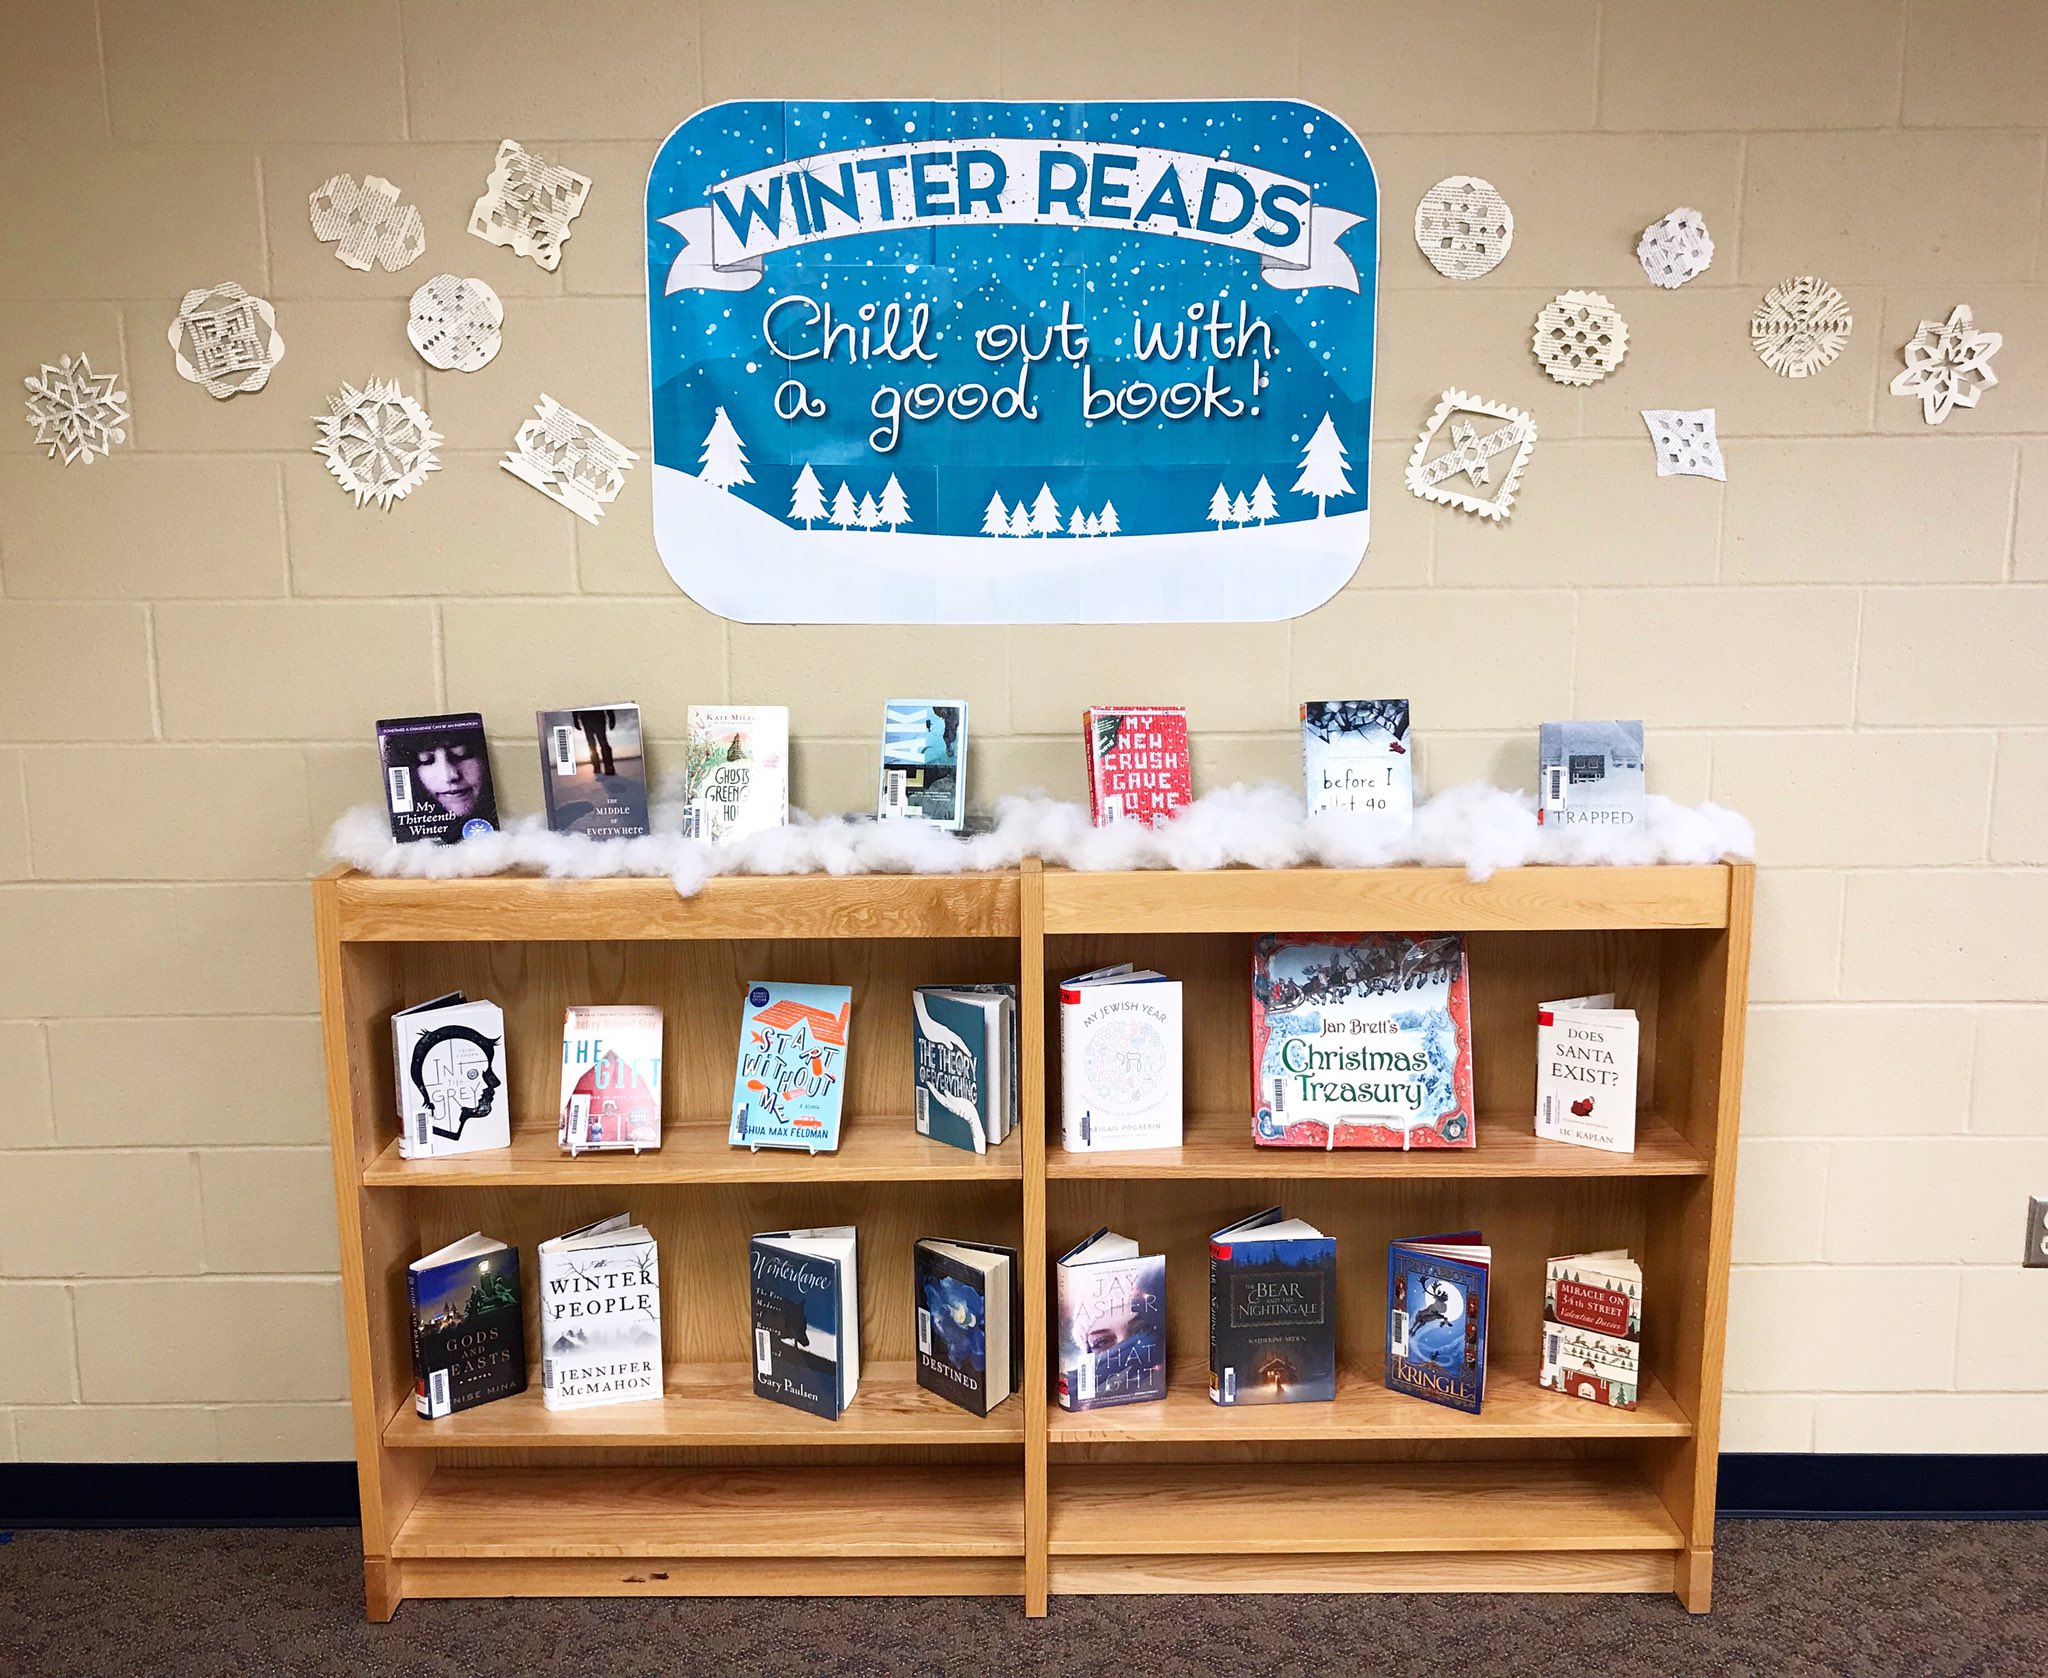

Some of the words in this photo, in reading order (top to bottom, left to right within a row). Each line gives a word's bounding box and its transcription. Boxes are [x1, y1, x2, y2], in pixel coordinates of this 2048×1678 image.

[713, 150, 1006, 248] WINTER
[1038, 150, 1310, 248] READS
[762, 294, 938, 361] Chill
[976, 301, 1088, 362] out
[1133, 301, 1279, 362] with
[774, 382, 826, 418] a
[868, 362, 1037, 453] good
[1082, 364, 1263, 419] book!
[1126, 717, 1152, 730] MY
[1119, 733, 1162, 750] NEW
[1104, 752, 1177, 770] CRUSH
[715, 767, 749, 785] GHOSTS
[1113, 772, 1171, 790] GAVE
[1323, 768, 1376, 790] before
[1387, 767, 1393, 786] I
[416, 802, 435, 813] My
[1151, 792, 1180, 809] ME
[397, 811, 456, 826] Thirteenth
[1553, 810, 1634, 824] TRAPPED
[409, 824, 448, 836] Winter
[1084, 1012, 1098, 1028] MY
[1100, 1002, 1139, 1018] JEWISH
[1142, 1002, 1167, 1023] YEAR
[1320, 1018, 1346, 1038] Jan
[1350, 1018, 1398, 1035] Brett's
[1568, 1028, 1604, 1043] DOES
[563, 1040, 603, 1064] THE
[758, 1027, 840, 1067] START
[1282, 1038, 1428, 1074] Christmas
[1556, 1044, 1614, 1064] SANTA
[918, 1038, 936, 1068] THE
[938, 1044, 978, 1082] THEORY
[594, 1058, 660, 1089] GIFT
[1552, 1062, 1619, 1086] EXIST?
[919, 1068, 930, 1084] OF
[930, 1068, 978, 1105] EVERYTHING
[1294, 1072, 1422, 1110] Treasury
[758, 1086, 790, 1124] ME
[744, 1124, 766, 1136] SHUA
[769, 1126, 788, 1138] MAX
[790, 1128, 828, 1139] FELDMAN
[1576, 1130, 1614, 1144] KAPLAN
[550, 1270, 652, 1296] WINTER
[751, 1251, 832, 1294] Winterdance
[1092, 1274, 1140, 1298] JAY
[1253, 1282, 1304, 1301] BEAR
[1561, 1284, 1605, 1302] MIRACLE
[1609, 1294, 1626, 1306] ON
[554, 1294, 652, 1320] PEOPLE
[1076, 1294, 1158, 1320] ASHER
[1240, 1304, 1318, 1318] NIGHTINGALE
[1560, 1307, 1595, 1324] Valentine
[1562, 1294, 1584, 1308] 34th
[1588, 1302, 1622, 1317] STREET
[446, 1327, 499, 1352] GODS
[451, 1350, 512, 1377] EASTS
[462, 1346, 486, 1360] AND
[560, 1360, 652, 1385] JENNIFER
[922, 1354, 978, 1391] DESTINED
[1095, 1367, 1158, 1393] IGHT
[1397, 1363, 1475, 1399] KRINGLE
[450, 1390, 482, 1405] NISE
[487, 1380, 518, 1395] MINA
[561, 1376, 652, 1397] McMAHON
[758, 1372, 783, 1393] Gary
[784, 1378, 819, 1402] Paulsen
